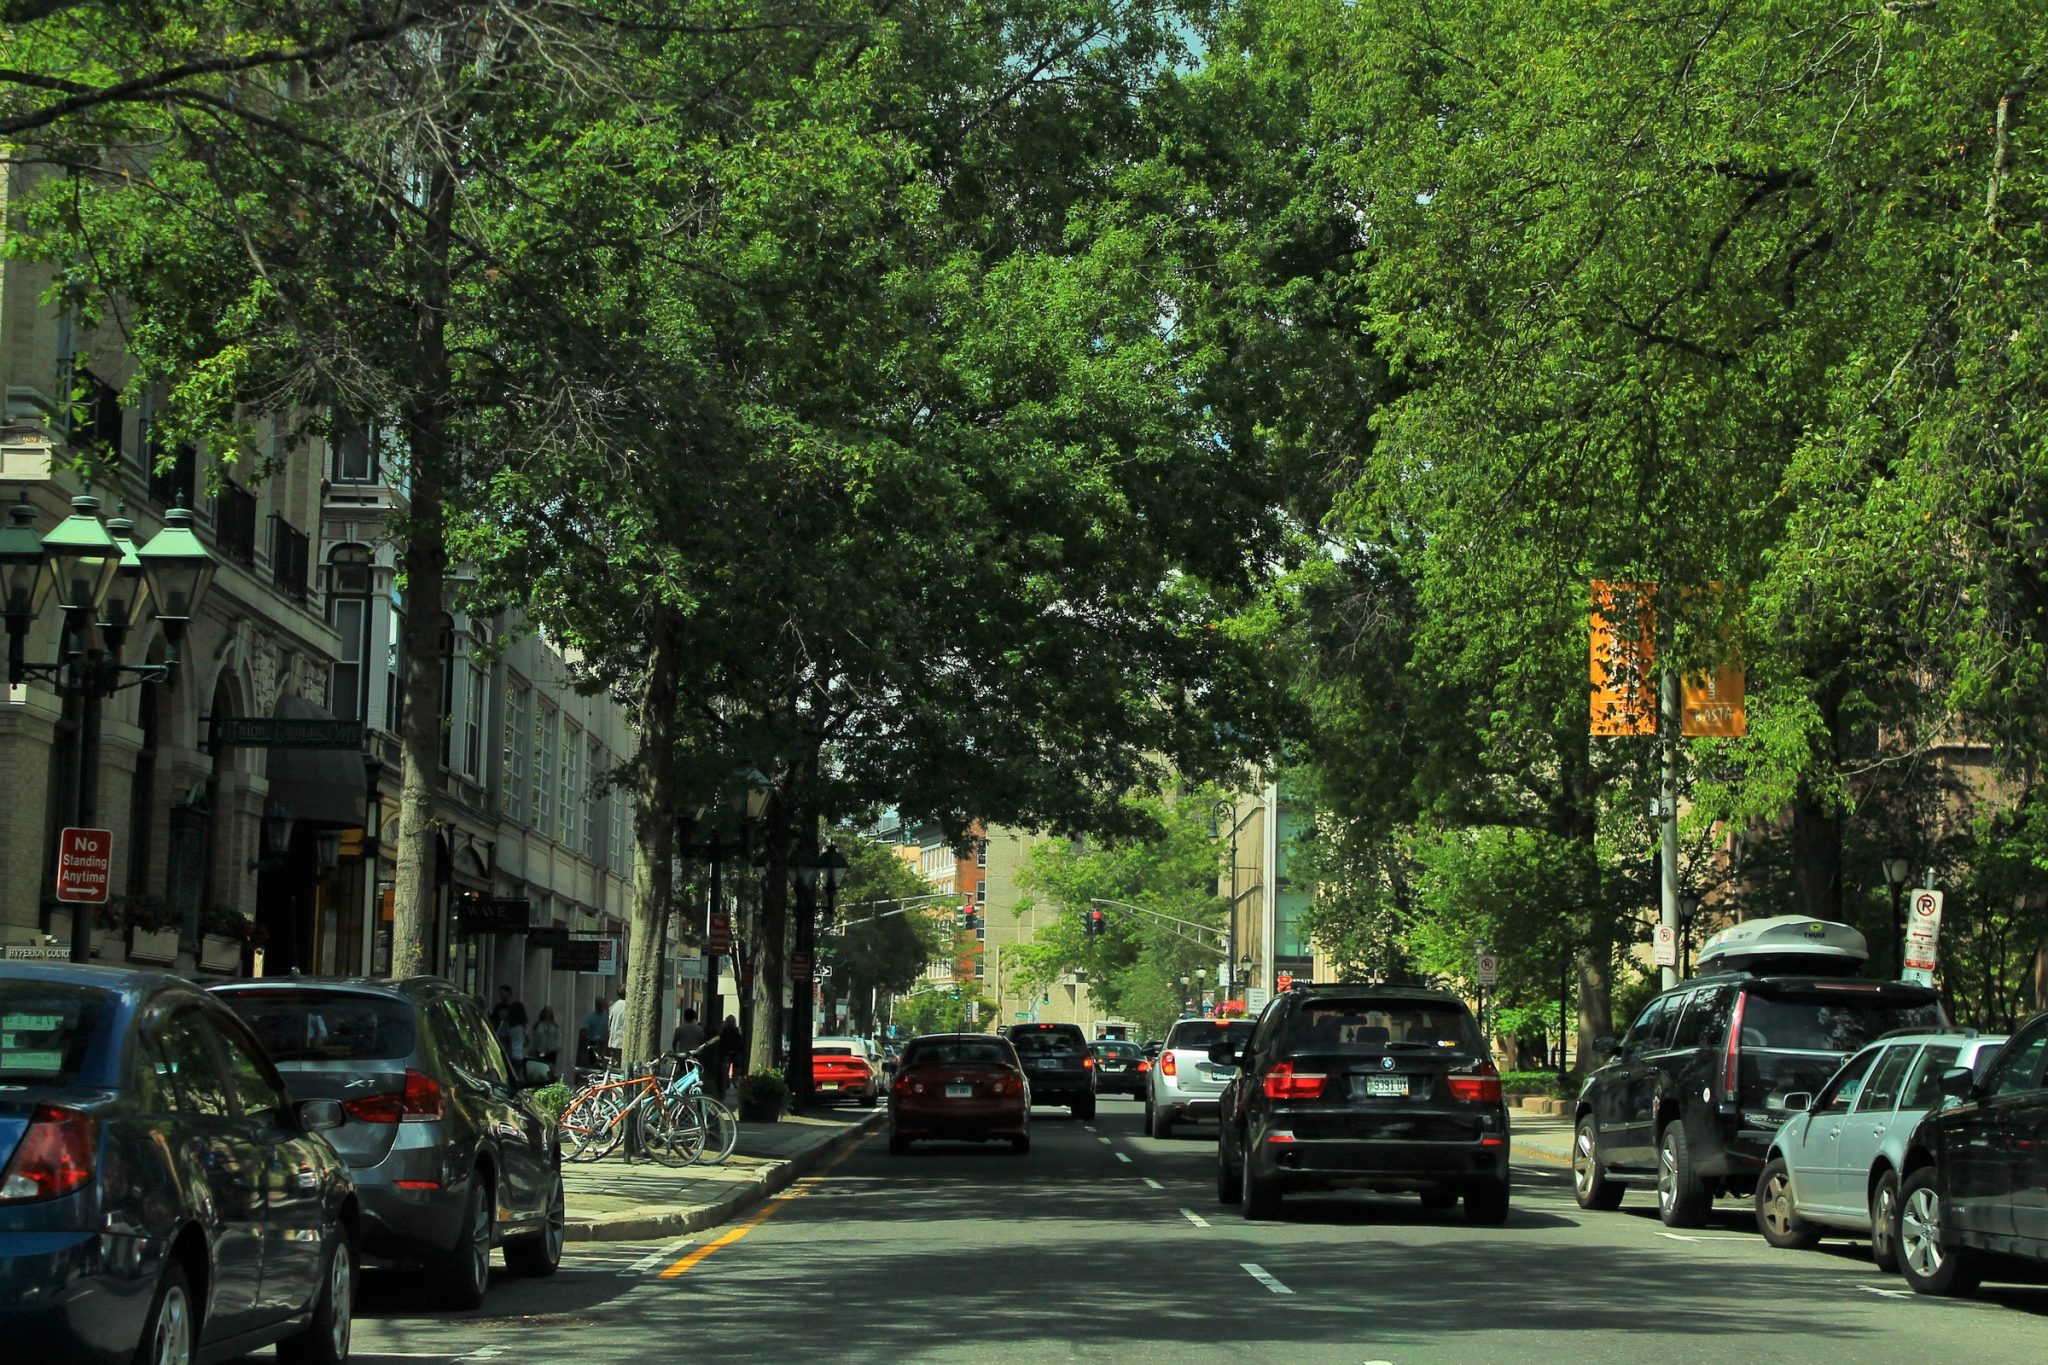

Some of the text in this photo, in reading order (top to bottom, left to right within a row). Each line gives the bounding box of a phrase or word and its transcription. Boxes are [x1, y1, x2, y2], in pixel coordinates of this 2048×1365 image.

[75, 837, 98, 852] No
[63, 854, 107, 870] Standing
[62, 869, 105, 884] Anytime
[465, 905, 507, 918] WAVE
[9, 948, 71, 959] HYPERION COURT
